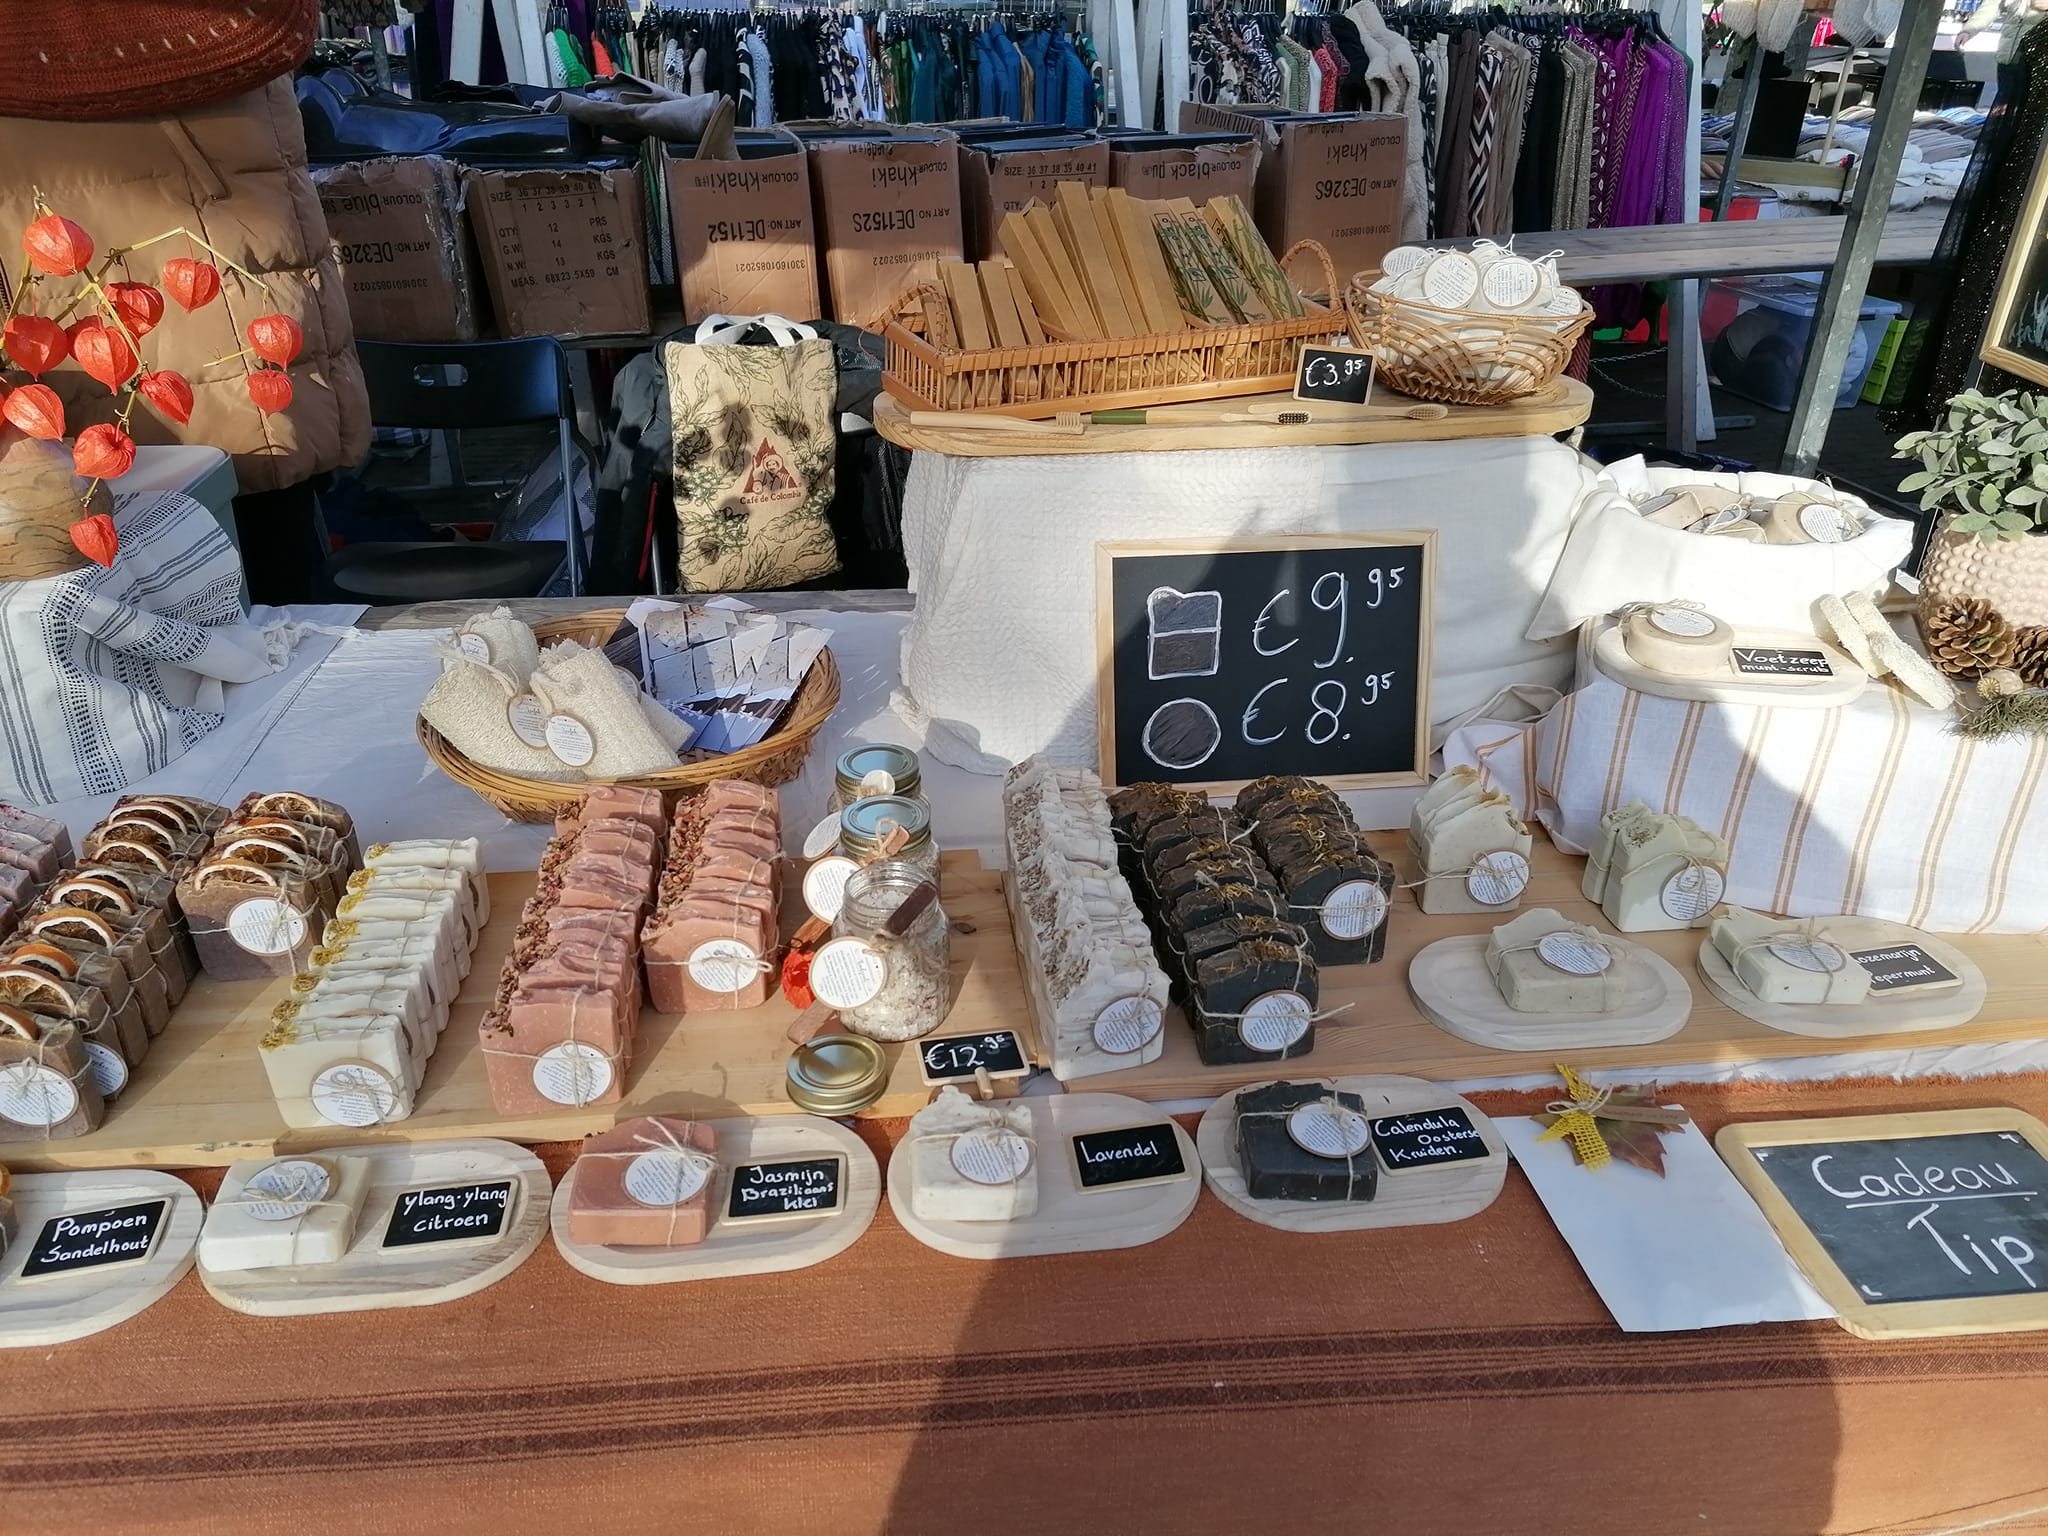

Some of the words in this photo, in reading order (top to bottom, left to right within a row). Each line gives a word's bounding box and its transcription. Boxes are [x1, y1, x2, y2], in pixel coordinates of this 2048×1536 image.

[1326, 142, 1368, 166] khaki
[872, 166, 918, 188] khaki
[1039, 166, 1048, 174] 37
[1171, 162, 1210, 181] black
[710, 171, 760, 194] khaki
[1314, 178, 1367, 200] DE326S
[1383, 178, 1398, 189] ART
[344, 194, 382, 216] blue
[933, 208, 950, 218] ART
[548, 222, 558, 233] 12
[589, 216, 608, 226] PRS
[767, 220, 783, 230] NO:
[784, 218, 801, 229] ART
[852, 208, 915, 233] DE1152S
[552, 240, 562, 249] 14
[593, 233, 612, 244] KGS
[707, 218, 766, 244] DE1152
[330, 242, 394, 265] DE326S
[413, 241, 430, 252] ART
[556, 256, 566, 266] 13
[596, 250, 616, 261] KGS
[606, 267, 620, 277] CM
[740, 494, 759, 505] Café
[760, 494, 768, 503] de
[770, 490, 801, 501] Colombia
[1857, 948, 1922, 965] ozemarijn
[1374, 1116, 1460, 1136] Calendula
[1417, 1130, 1481, 1145] Oosterse
[1080, 1140, 1158, 1164] Lavendel
[750, 1166, 825, 1186] Jasmijn
[1811, 1154, 2019, 1199] Cadeau
[741, 1182, 834, 1202] Braziliaans
[52, 1215, 148, 1242] Pompoen
[413, 1214, 488, 1232] citroen
[40, 1235, 150, 1263] Sandelhout
[1907, 1202, 2037, 1289] Tip
